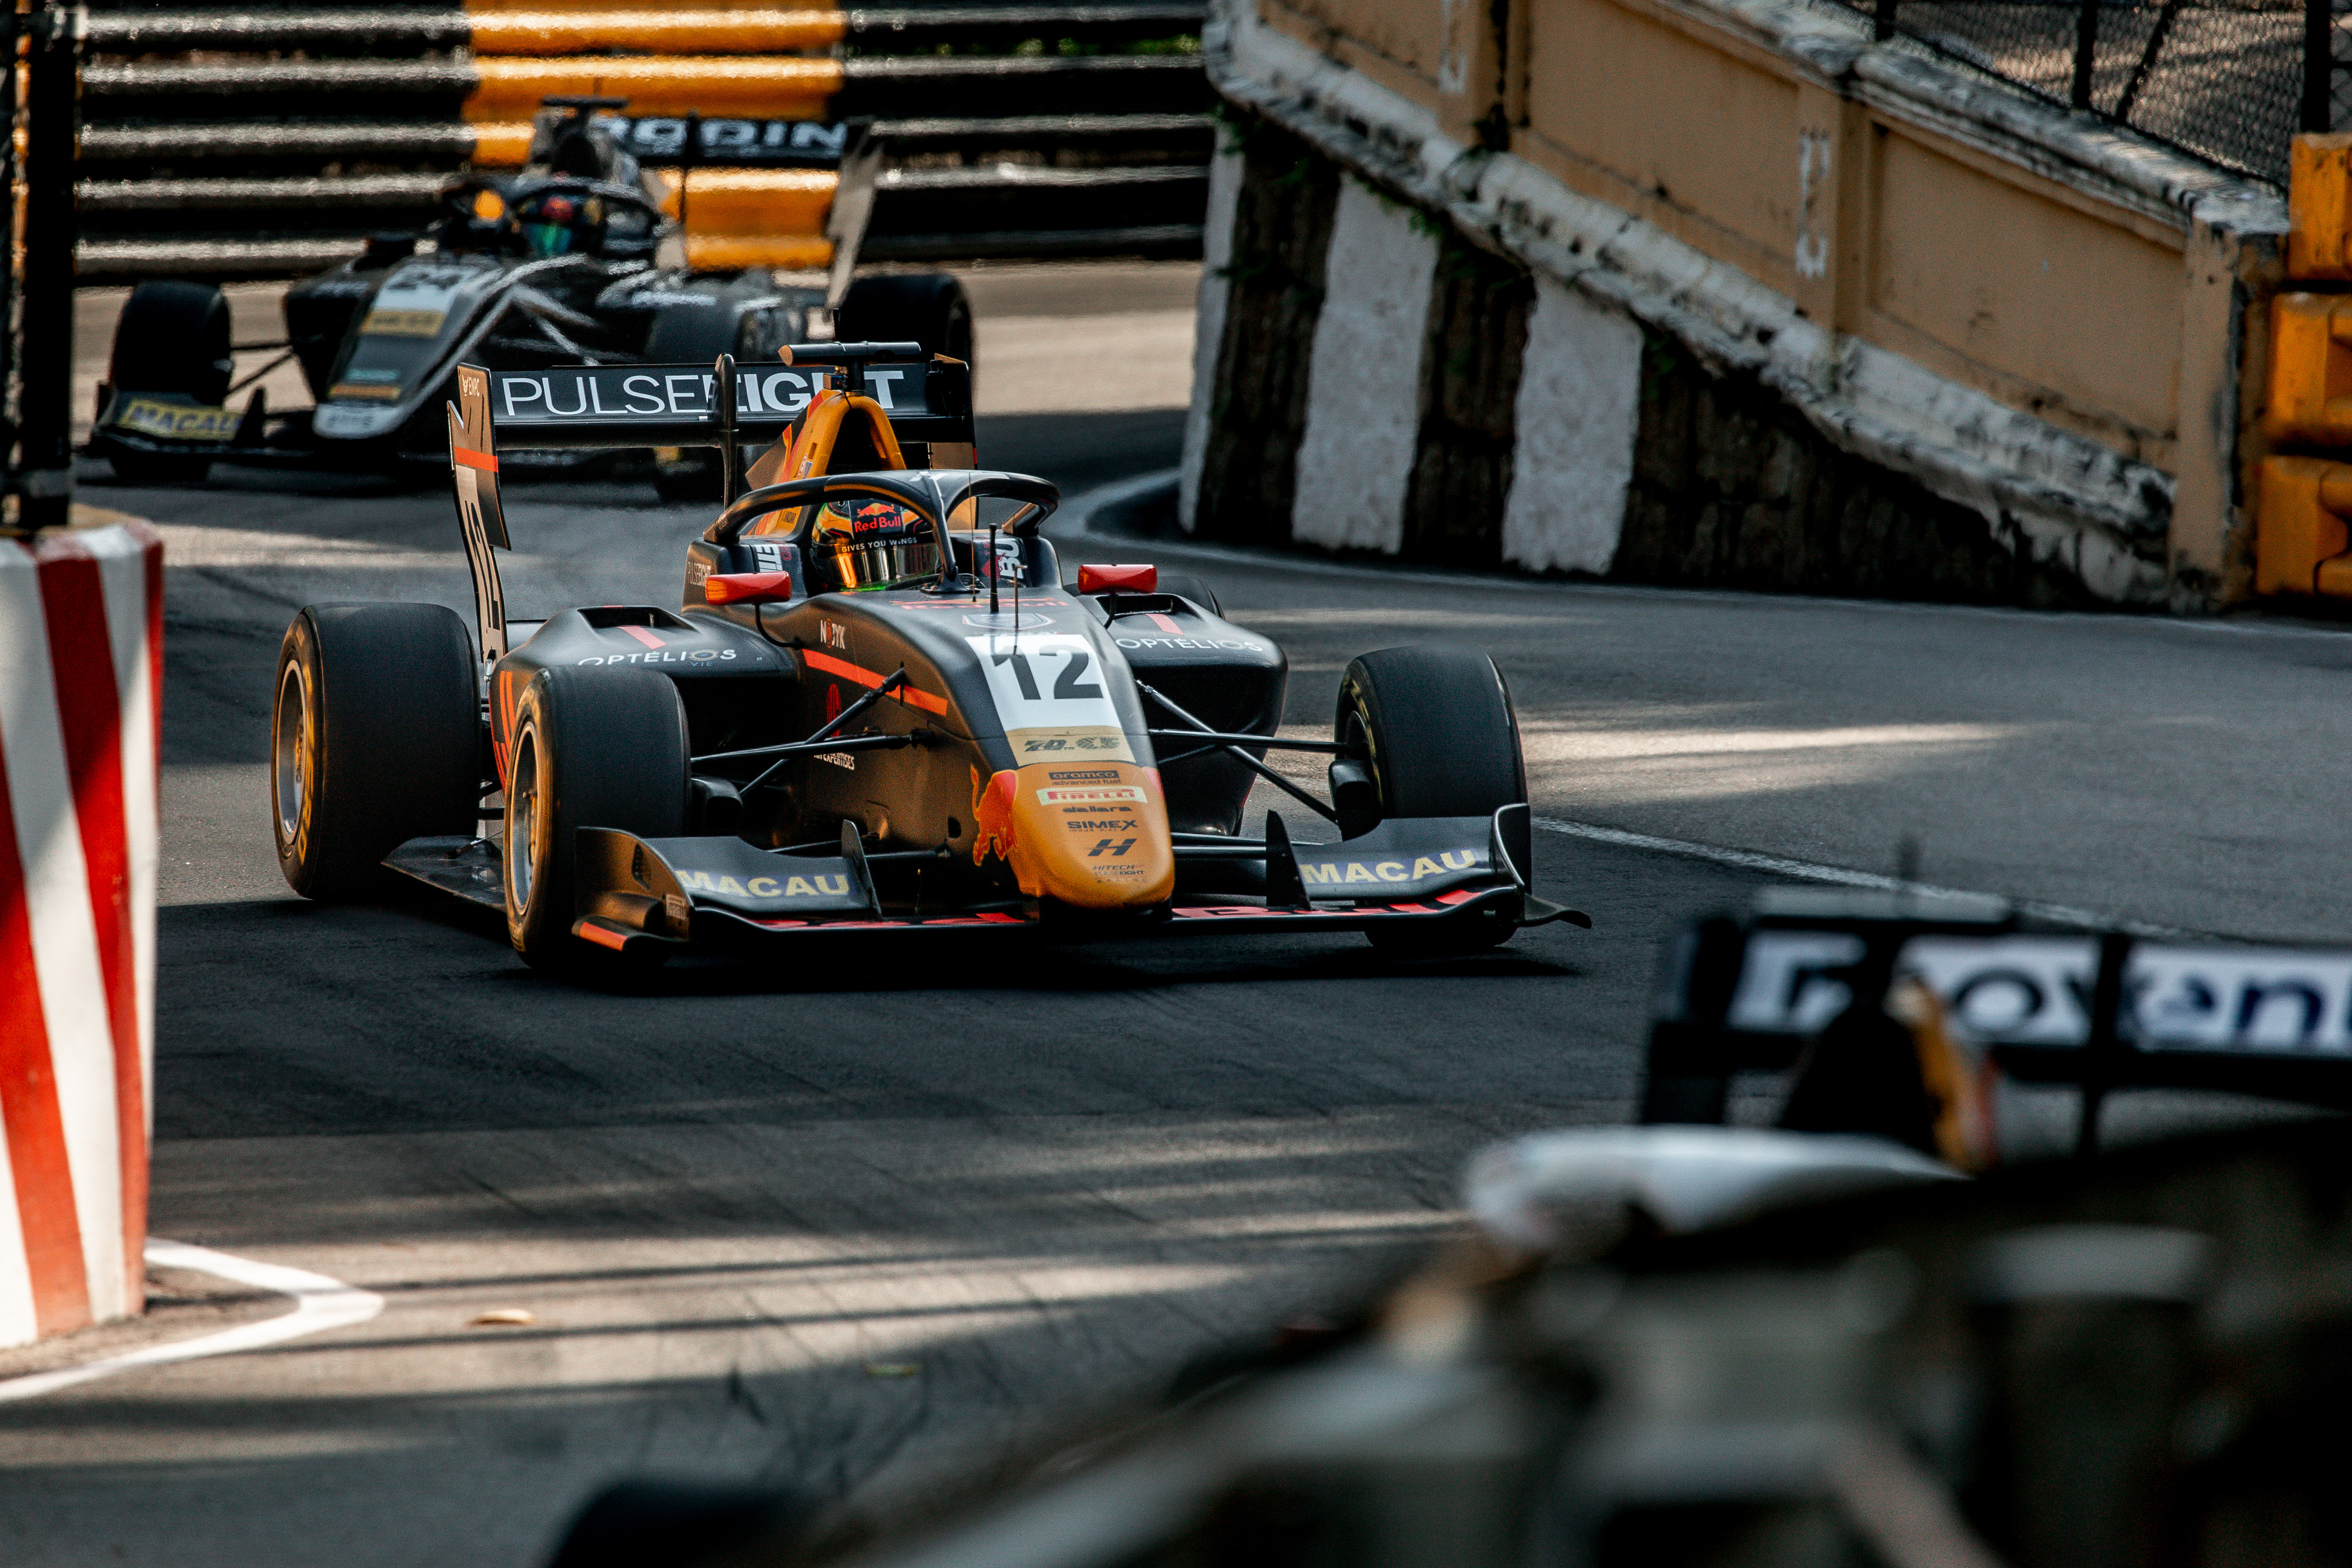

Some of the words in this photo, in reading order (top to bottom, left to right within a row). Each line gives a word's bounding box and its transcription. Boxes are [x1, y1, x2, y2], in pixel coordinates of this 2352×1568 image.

[854, 517, 878, 533] Red
[879, 516, 901, 528] Bull
[841, 544, 865, 553] GIVES
[1115, 638, 1264, 652] OPTÉLIOS
[991, 645, 1104, 700] 12
[1053, 771, 1115, 780] aramco
[1047, 788, 1135, 800] PIRELLI
[1067, 820, 1138, 831] SIMEX
[1299, 849, 1477, 883] MACAU
[674, 870, 850, 897] MACAU
